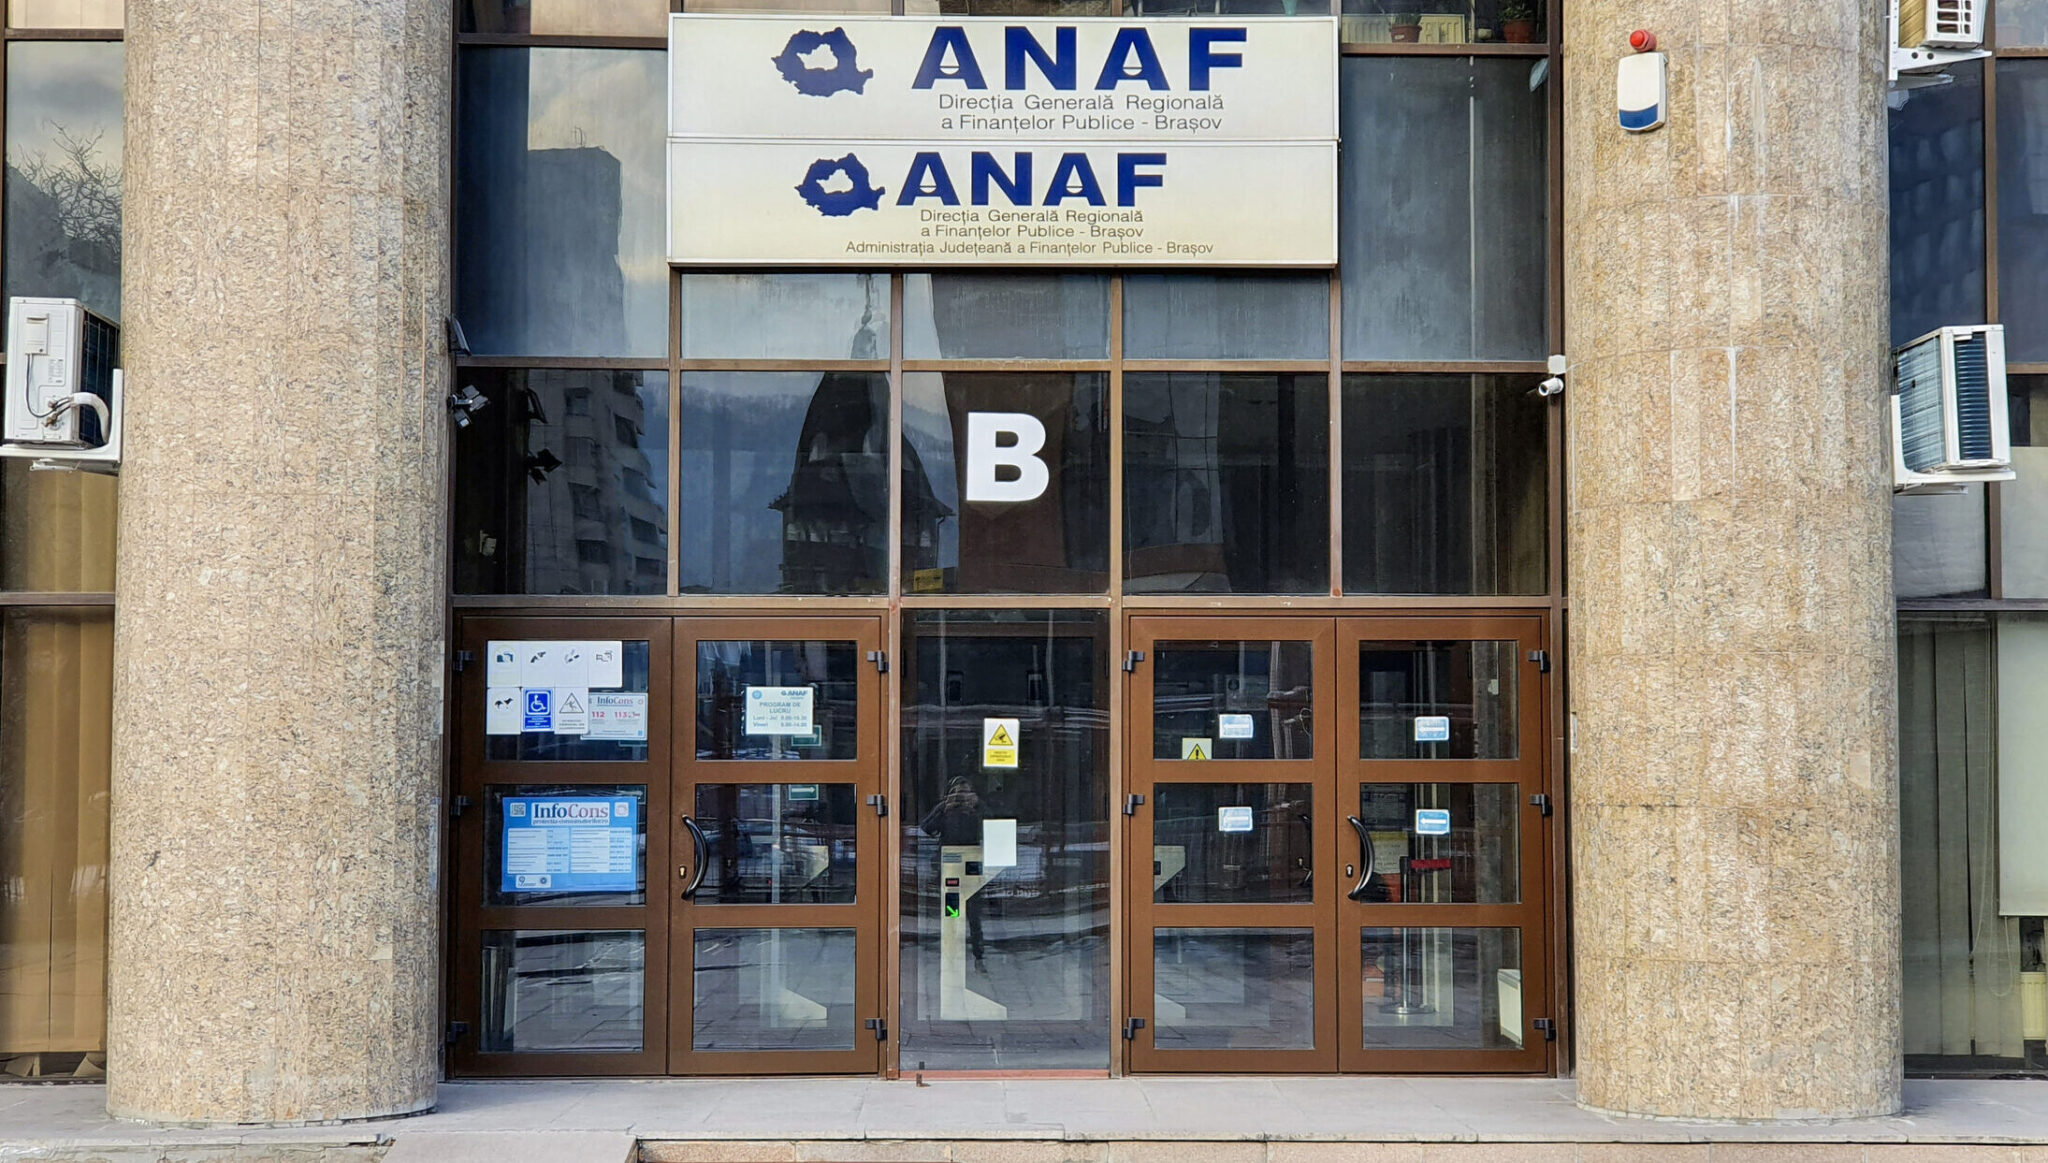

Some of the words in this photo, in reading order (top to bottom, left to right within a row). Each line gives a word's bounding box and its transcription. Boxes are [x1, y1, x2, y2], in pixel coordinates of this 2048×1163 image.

[912, 26, 1247, 91] ANAF
[939, 94, 1014, 113] Direcția
[1024, 94, 1114, 110] Generală
[1126, 94, 1224, 114] Regională
[941, 118, 953, 129] a
[960, 115, 1055, 135] Finanțelor
[1062, 115, 1135, 130] Publice
[1155, 115, 1222, 134] Brașov
[896, 151, 1167, 207] ANAF
[920, 209, 979, 226] Direcția
[988, 209, 1059, 222] Generală
[1066, 210, 1144, 226] Regională
[921, 227, 930, 237] a
[935, 225, 1011, 241] Finanțelor
[1017, 225, 1075, 237] Publice
[1090, 225, 1144, 240] Brașov
[846, 241, 934, 256] Administrația
[939, 241, 1012, 257] Județeană
[1017, 244, 1026, 253] a
[1030, 241, 1097, 257] Finanțelor
[1103, 242, 1153, 254] Publice
[1167, 241, 1214, 257] Brașov
[966, 412, 1050, 502] B
[597, 696, 634, 704] InfoCons
[533, 803, 609, 819] InfoCons
